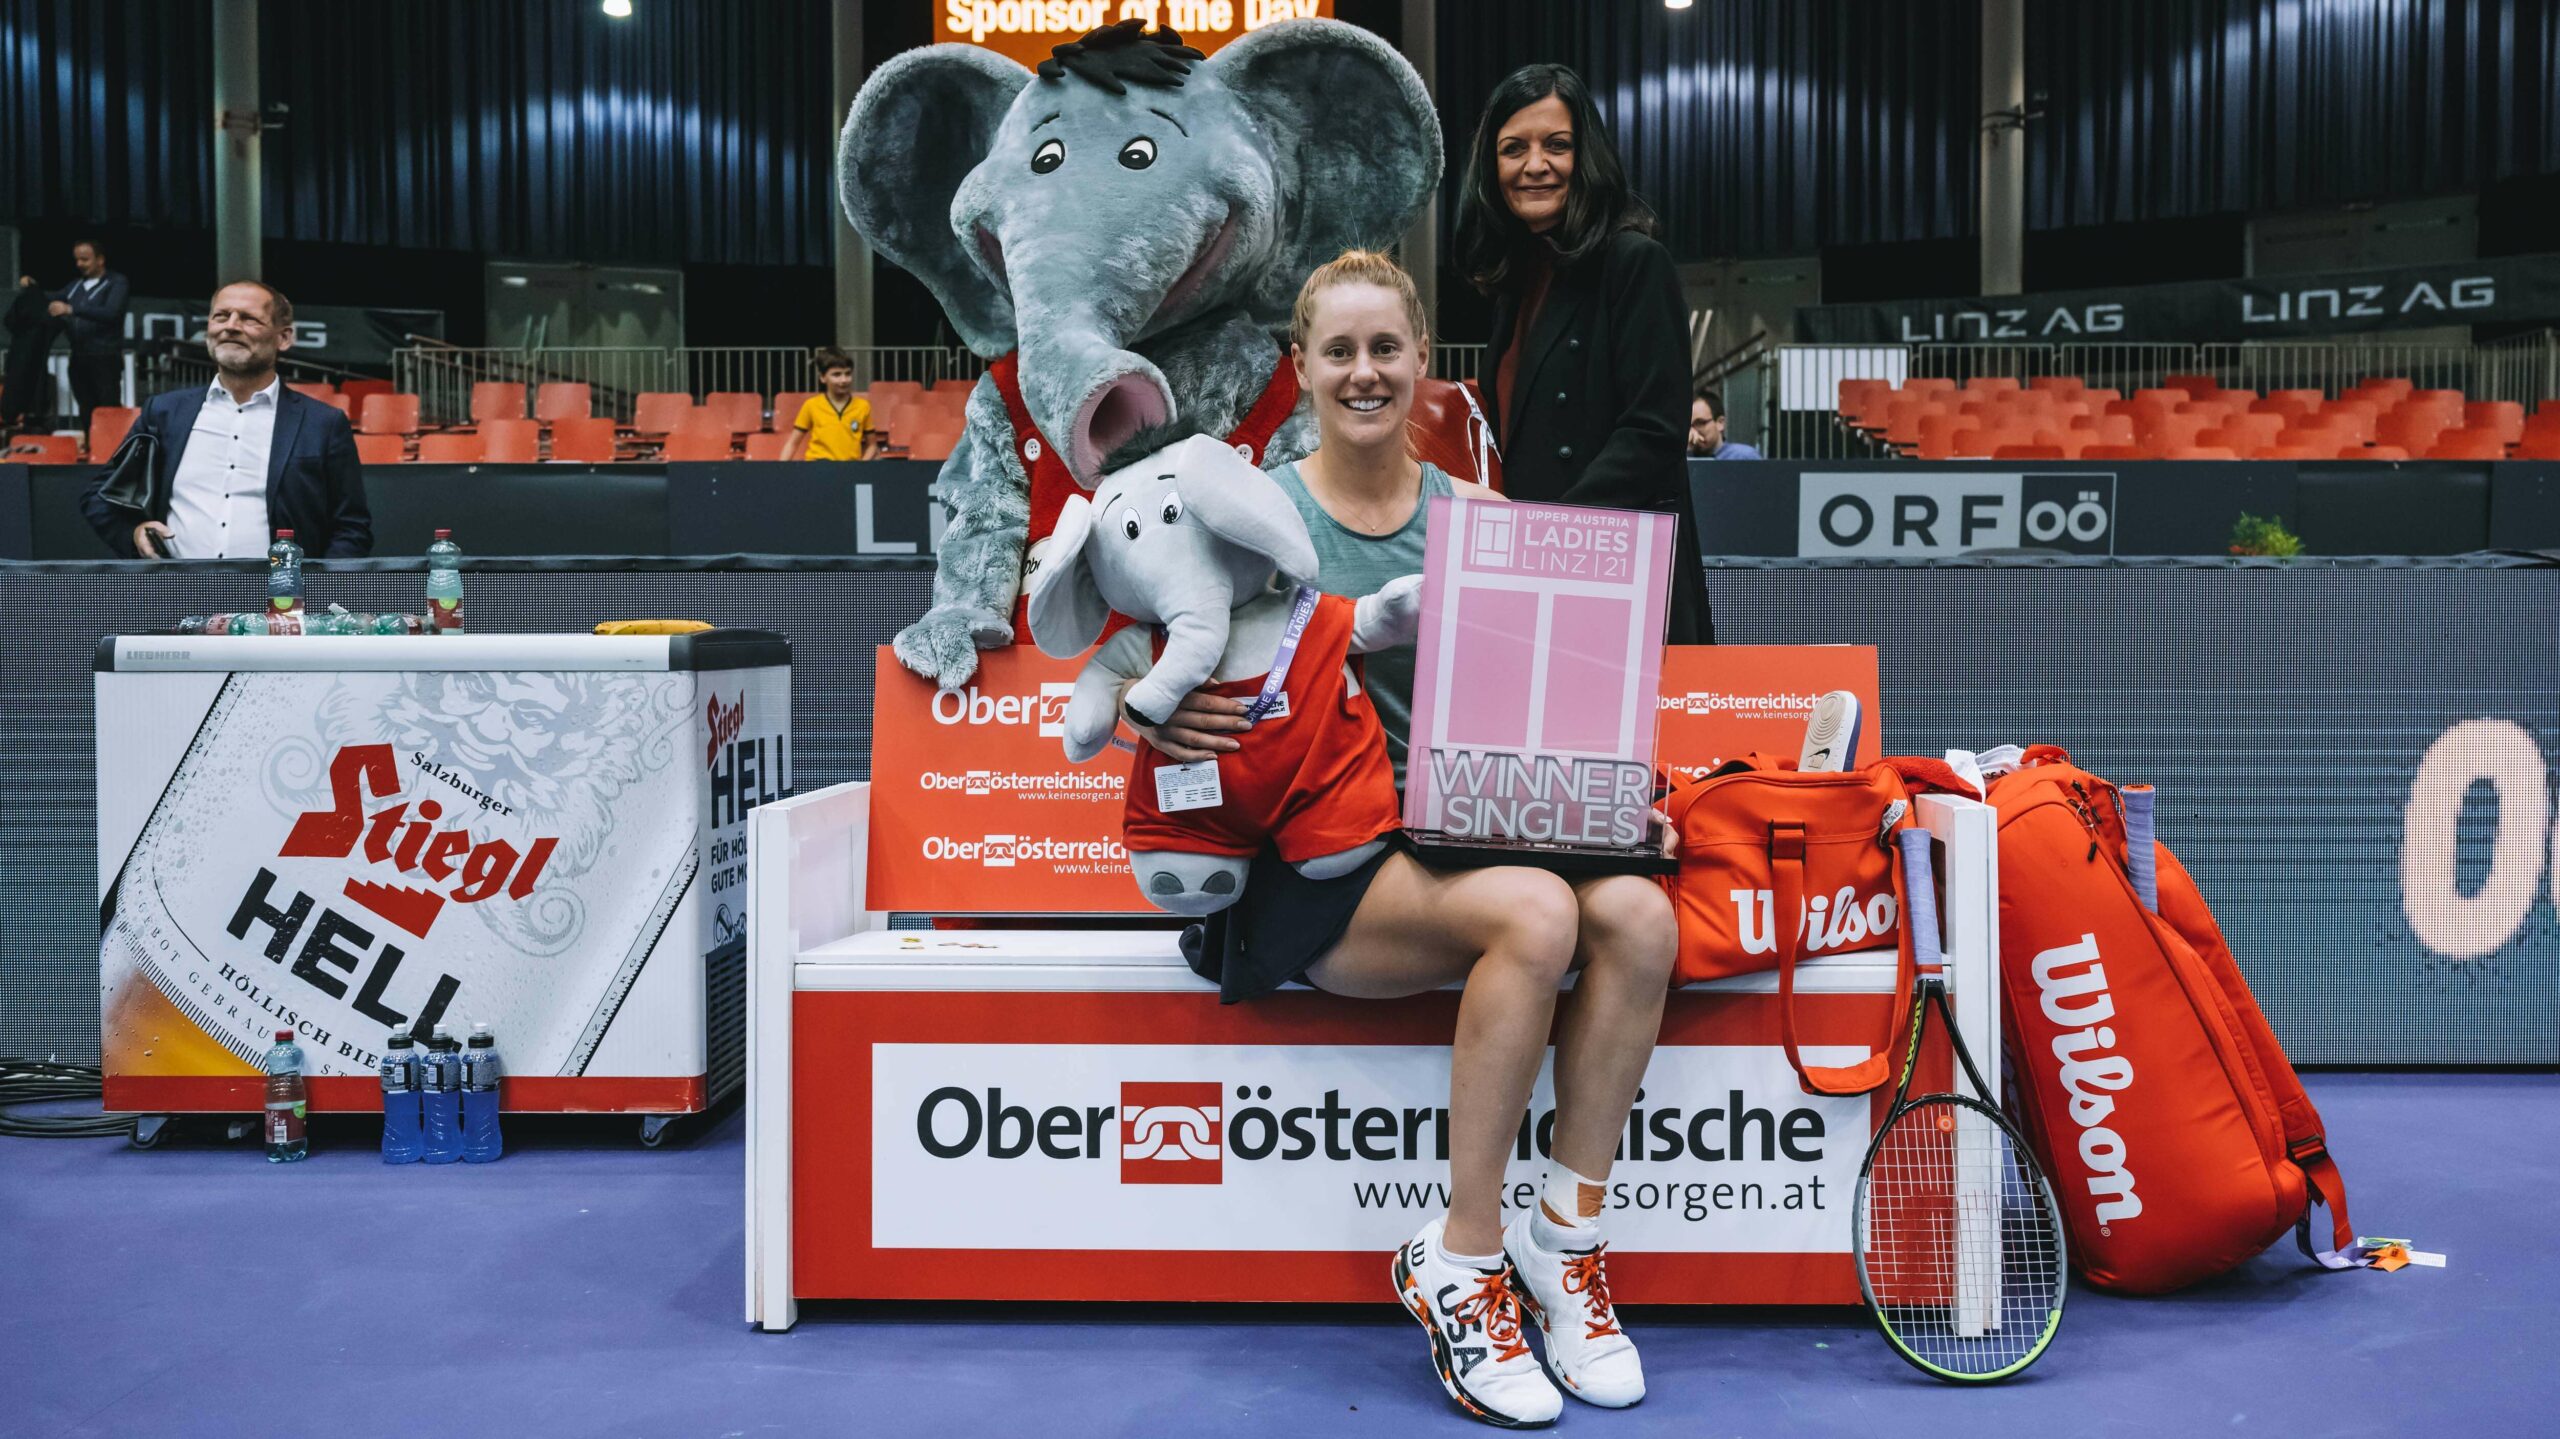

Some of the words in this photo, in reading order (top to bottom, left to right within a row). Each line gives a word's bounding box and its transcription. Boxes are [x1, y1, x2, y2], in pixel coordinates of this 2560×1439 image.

[946, 0, 1110, 42] Sponsor
[1167, 0, 1233, 32] the
[1901, 309, 2027, 342] LINZ
[2042, 304, 2124, 333] AG
[2242, 284, 2384, 324] LINZ
[2400, 278, 2496, 312] AG
[1524, 523, 1630, 553] LADIES
[1526, 510, 1570, 524] UPPER
[1573, 513, 1630, 529] AUSTRIA
[1818, 493, 2004, 547] ORF
[1291, 601, 1312, 639] LADIES
[126, 650, 191, 662] LIEBHERR
[931, 686, 1039, 725] Ober
[1257, 695, 1272, 712] THE
[1267, 665, 1286, 695] GAME
[1656, 693, 1687, 711] ber
[1709, 693, 1820, 711] österreichisch
[707, 689, 744, 772] Stiegl
[410, 750, 515, 819] Salzburger
[711, 734, 794, 829] HELL
[920, 772, 967, 790] Ober
[991, 772, 1124, 790] österreichische
[1018, 790, 1125, 802] www.keinesorgen.at
[1430, 748, 1650, 808] WINNER
[278, 743, 560, 904] Stiegl
[1444, 796, 1641, 848] SINGLES
[711, 836, 729, 866] FÜR
[922, 836, 984, 860] Ober
[711, 866, 735, 894] GUTE
[225, 866, 462, 1054] HELL
[188, 971, 271, 1040] GEBRAU
[218, 962, 332, 1047] HÖLLISCH
[337, 1041, 384, 1074] BIE
[2031, 932, 2143, 1226] Wilson
[916, 1086, 1116, 1162] Ober
[1436, 1283, 1488, 1379] USA
